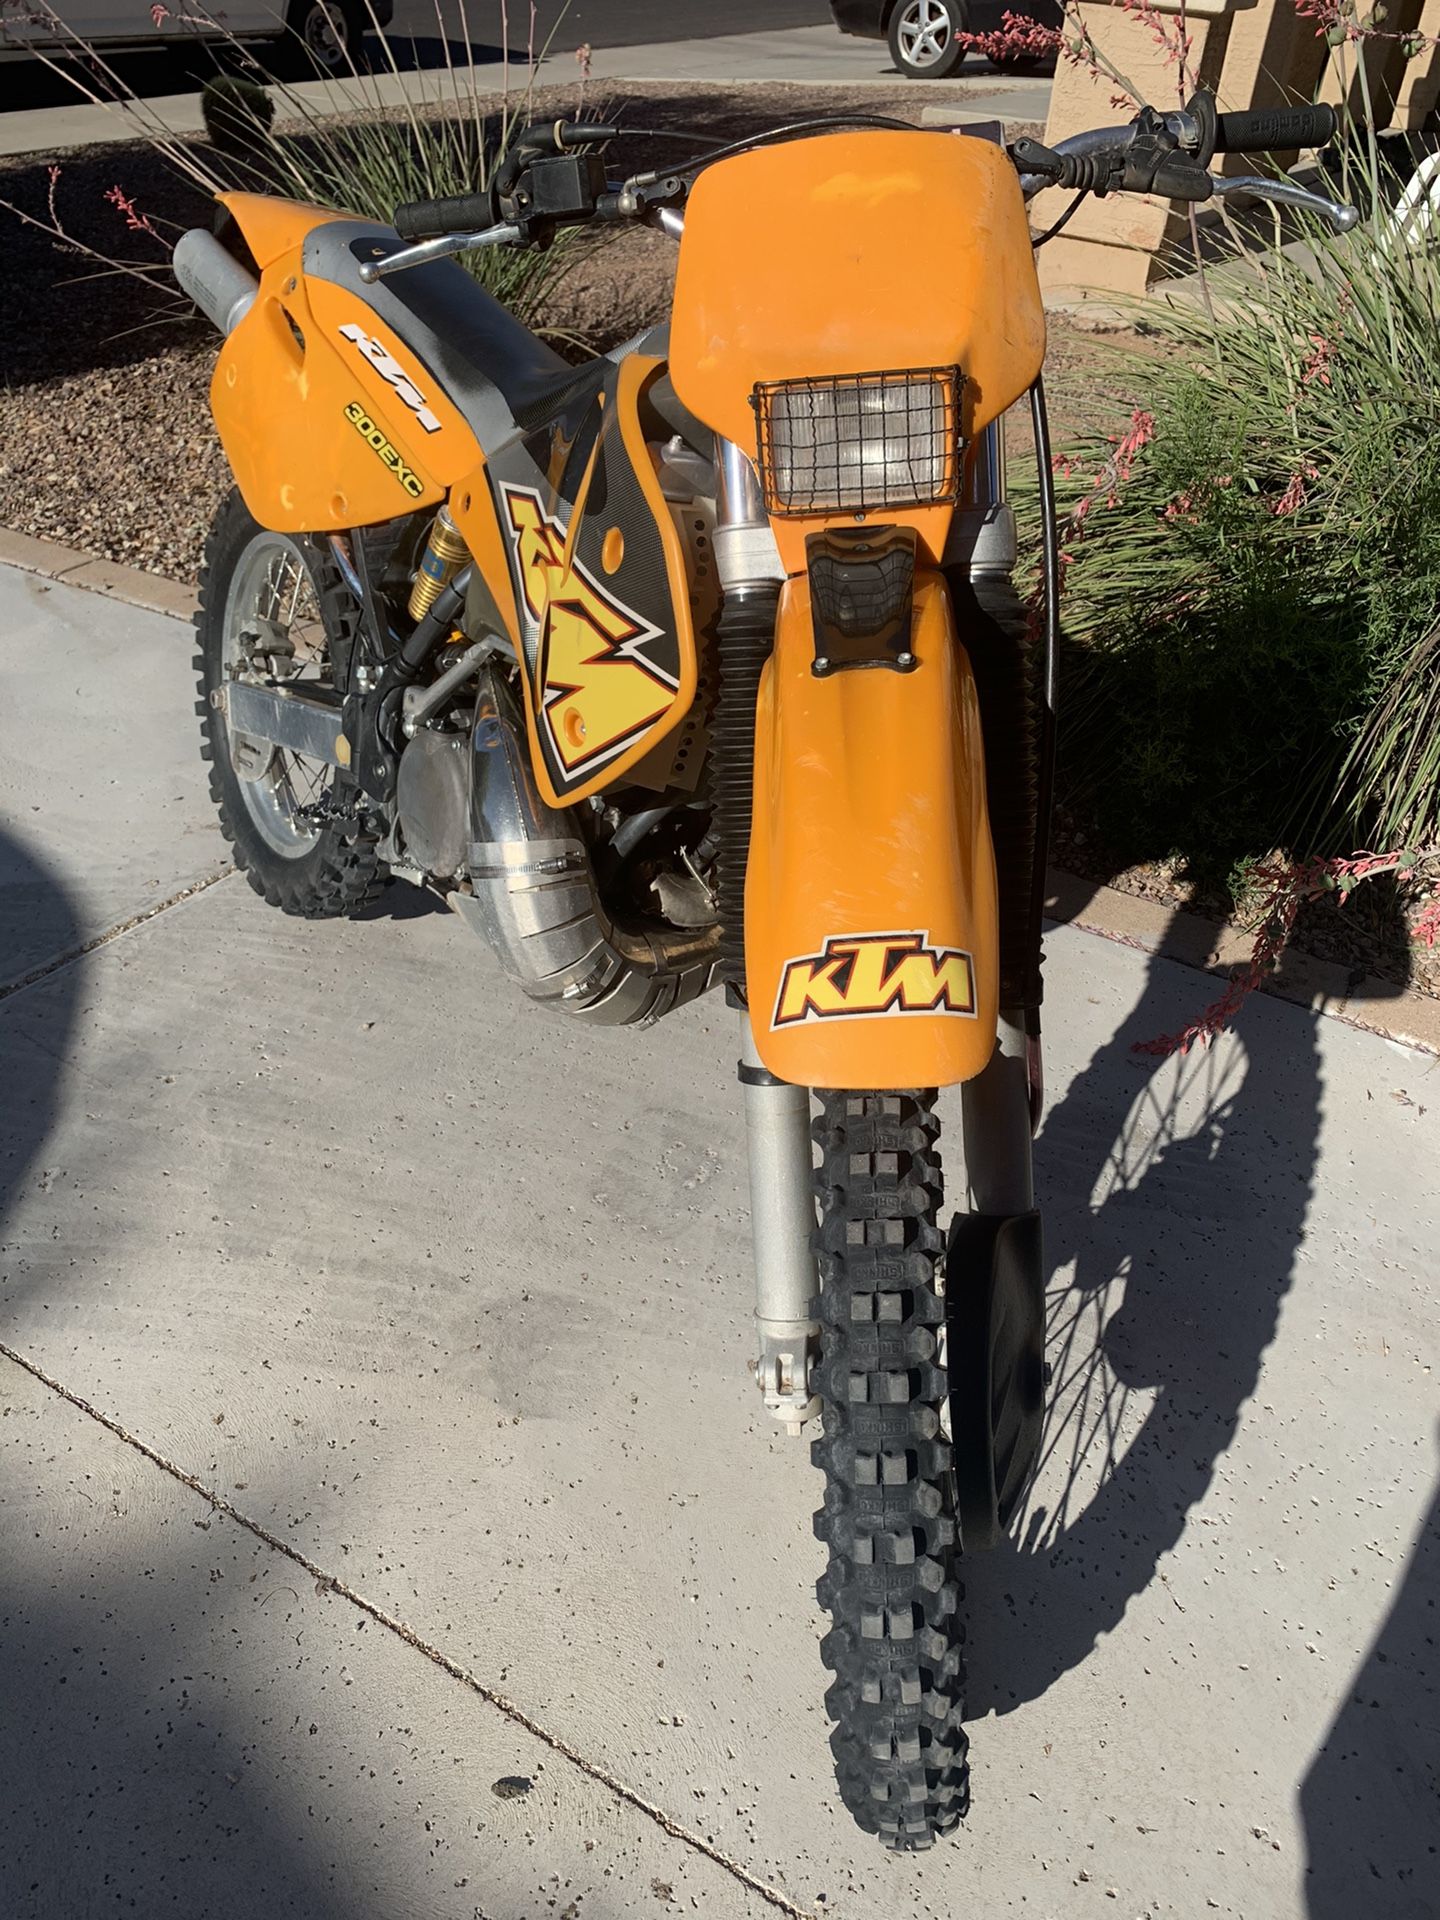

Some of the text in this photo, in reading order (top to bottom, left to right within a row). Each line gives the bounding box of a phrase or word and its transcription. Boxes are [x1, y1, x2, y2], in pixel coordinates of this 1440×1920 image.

[338, 323, 442, 434] KTM
[344, 402, 424, 497] 300EXC
[502, 486, 680, 777] KTM
[774, 934, 976, 1027] KTM
